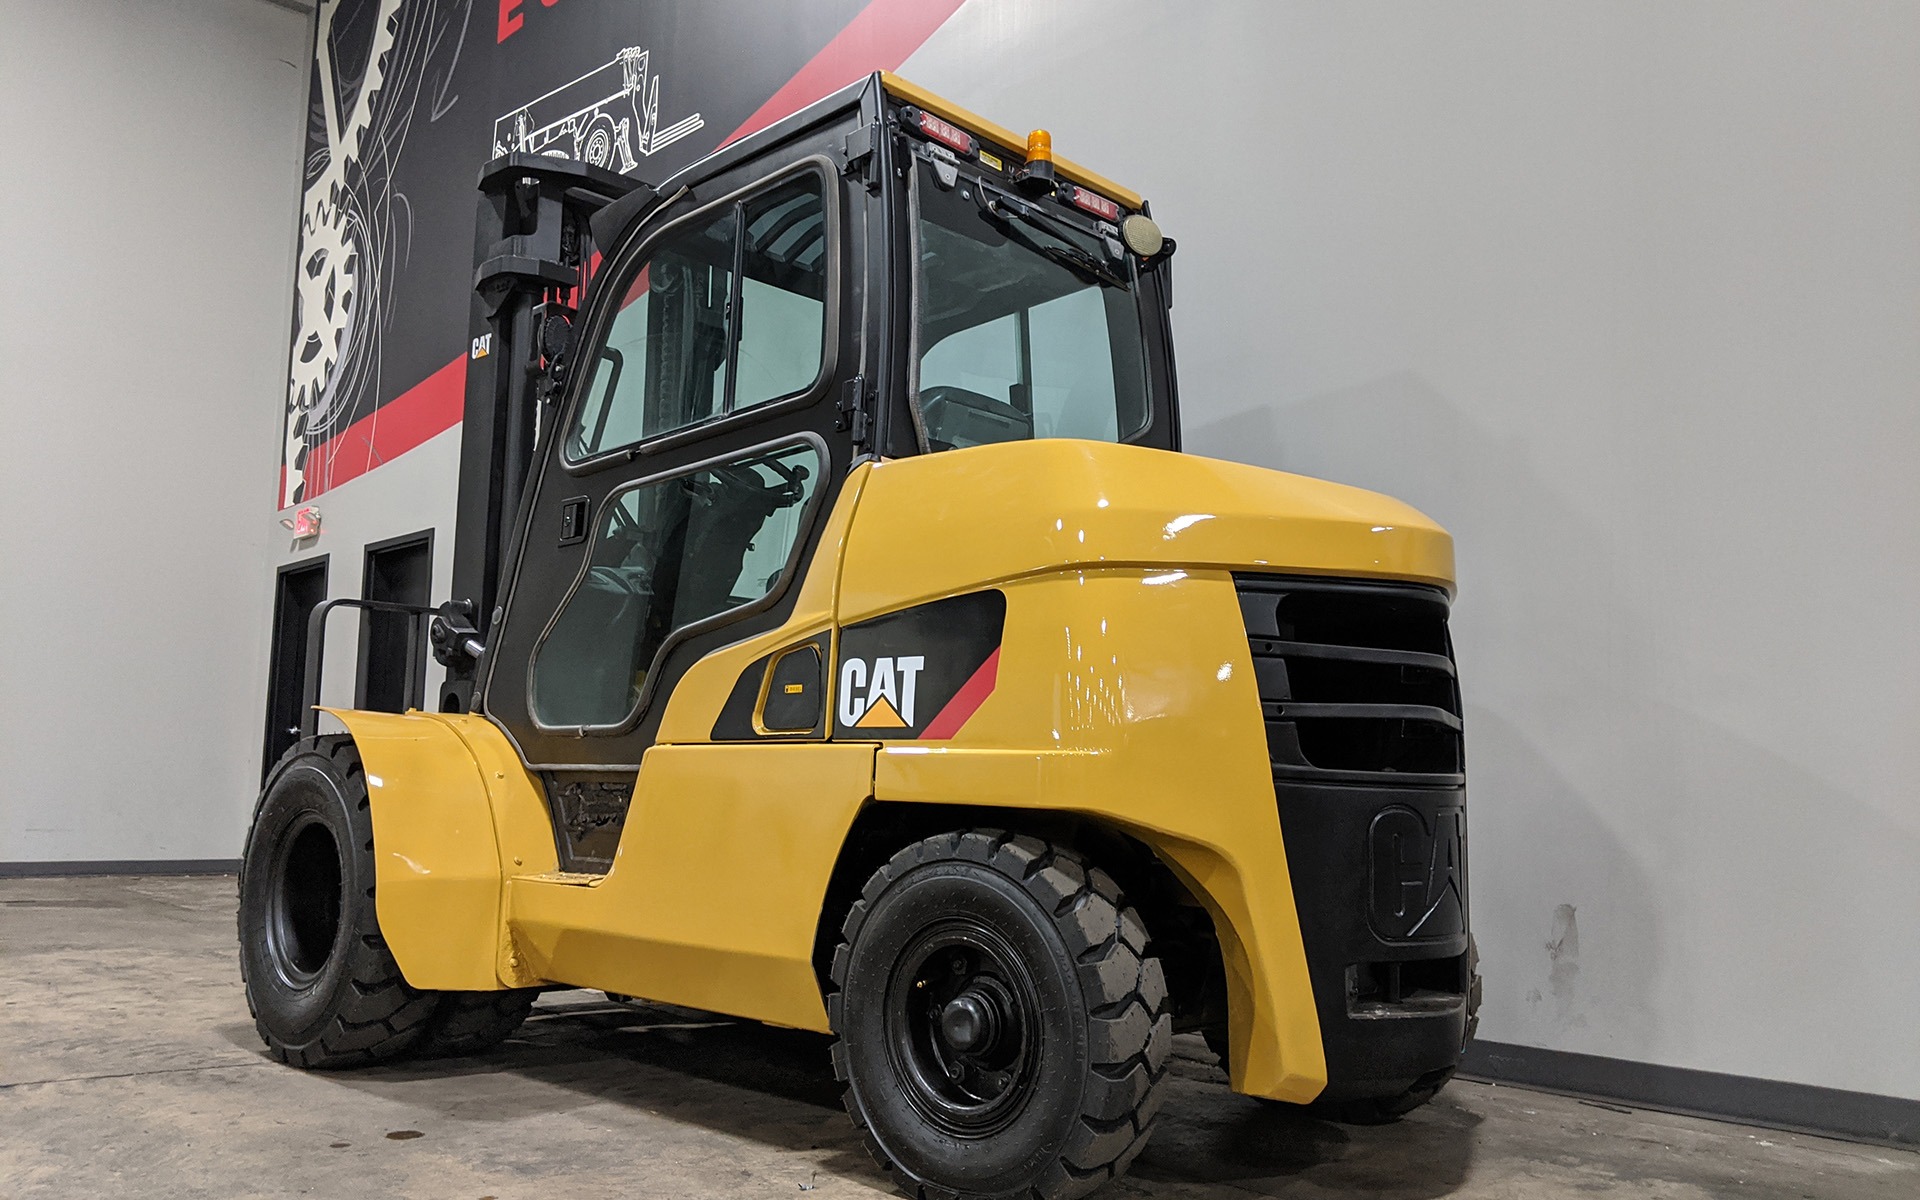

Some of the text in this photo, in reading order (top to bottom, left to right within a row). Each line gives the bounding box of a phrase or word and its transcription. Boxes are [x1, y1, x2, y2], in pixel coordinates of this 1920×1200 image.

[472, 333, 492, 360] CAT
[839, 655, 925, 728] CAT
[1367, 804, 1468, 943] CA
